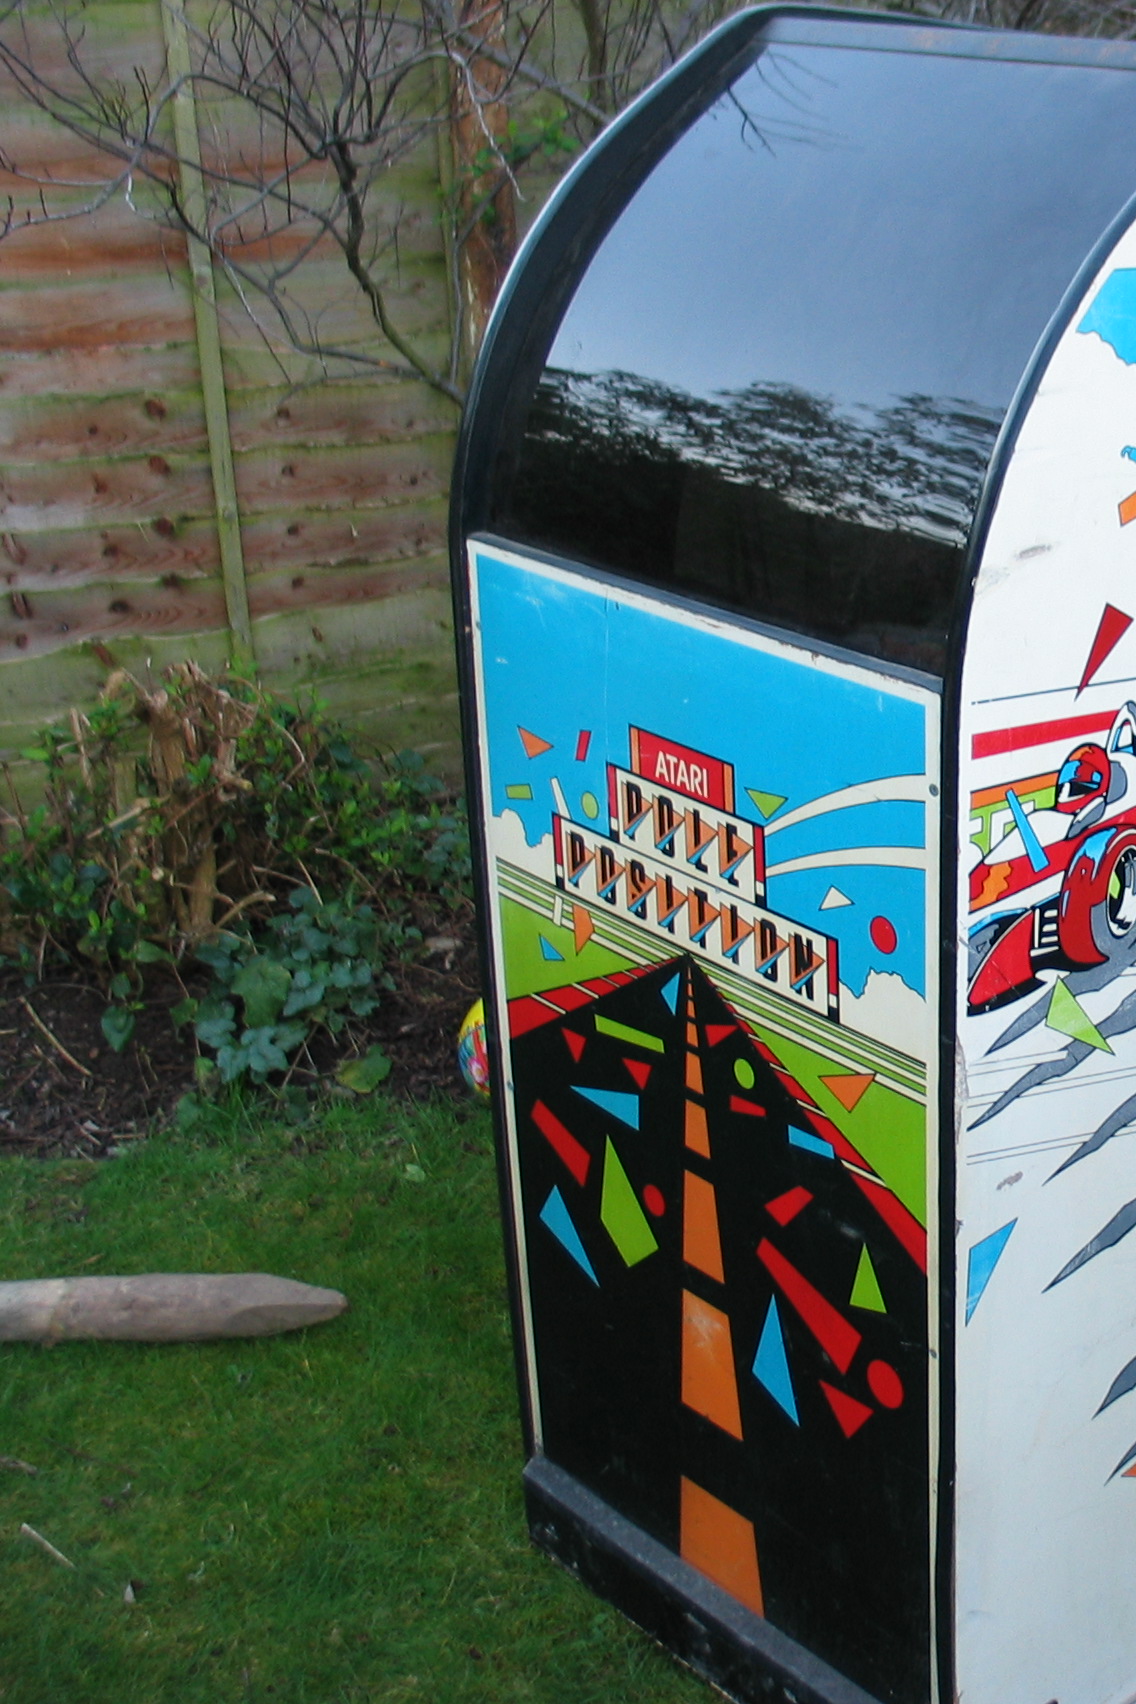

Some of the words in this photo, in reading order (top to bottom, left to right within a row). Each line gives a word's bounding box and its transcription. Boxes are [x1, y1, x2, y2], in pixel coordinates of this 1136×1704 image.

[655, 750, 708, 798] ATARI
[621, 779, 753, 888] POLE
[565, 829, 825, 1002] POSITION
